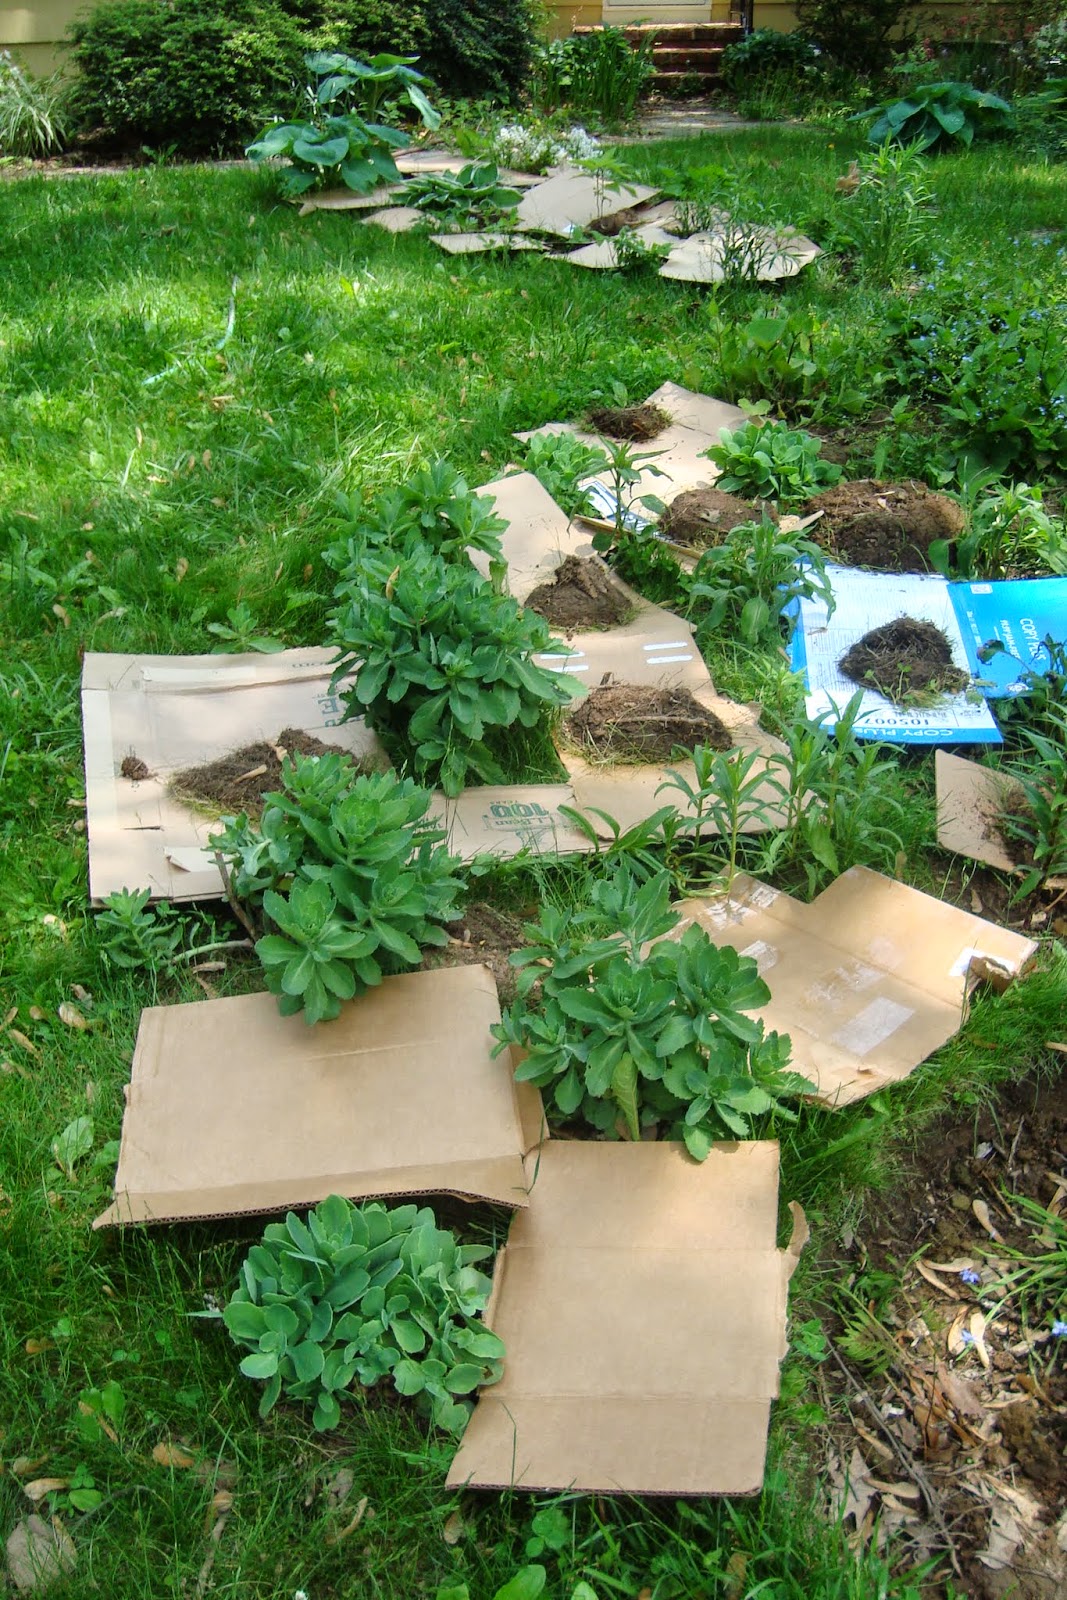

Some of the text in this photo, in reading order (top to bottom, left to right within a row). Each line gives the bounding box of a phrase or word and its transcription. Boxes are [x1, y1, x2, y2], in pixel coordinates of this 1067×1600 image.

[1020, 618, 1039, 640] COPY
[864, 718, 929, 726] 105007
[853, 727, 953, 737] COPY PLUS
[490, 803, 550, 818] 100
